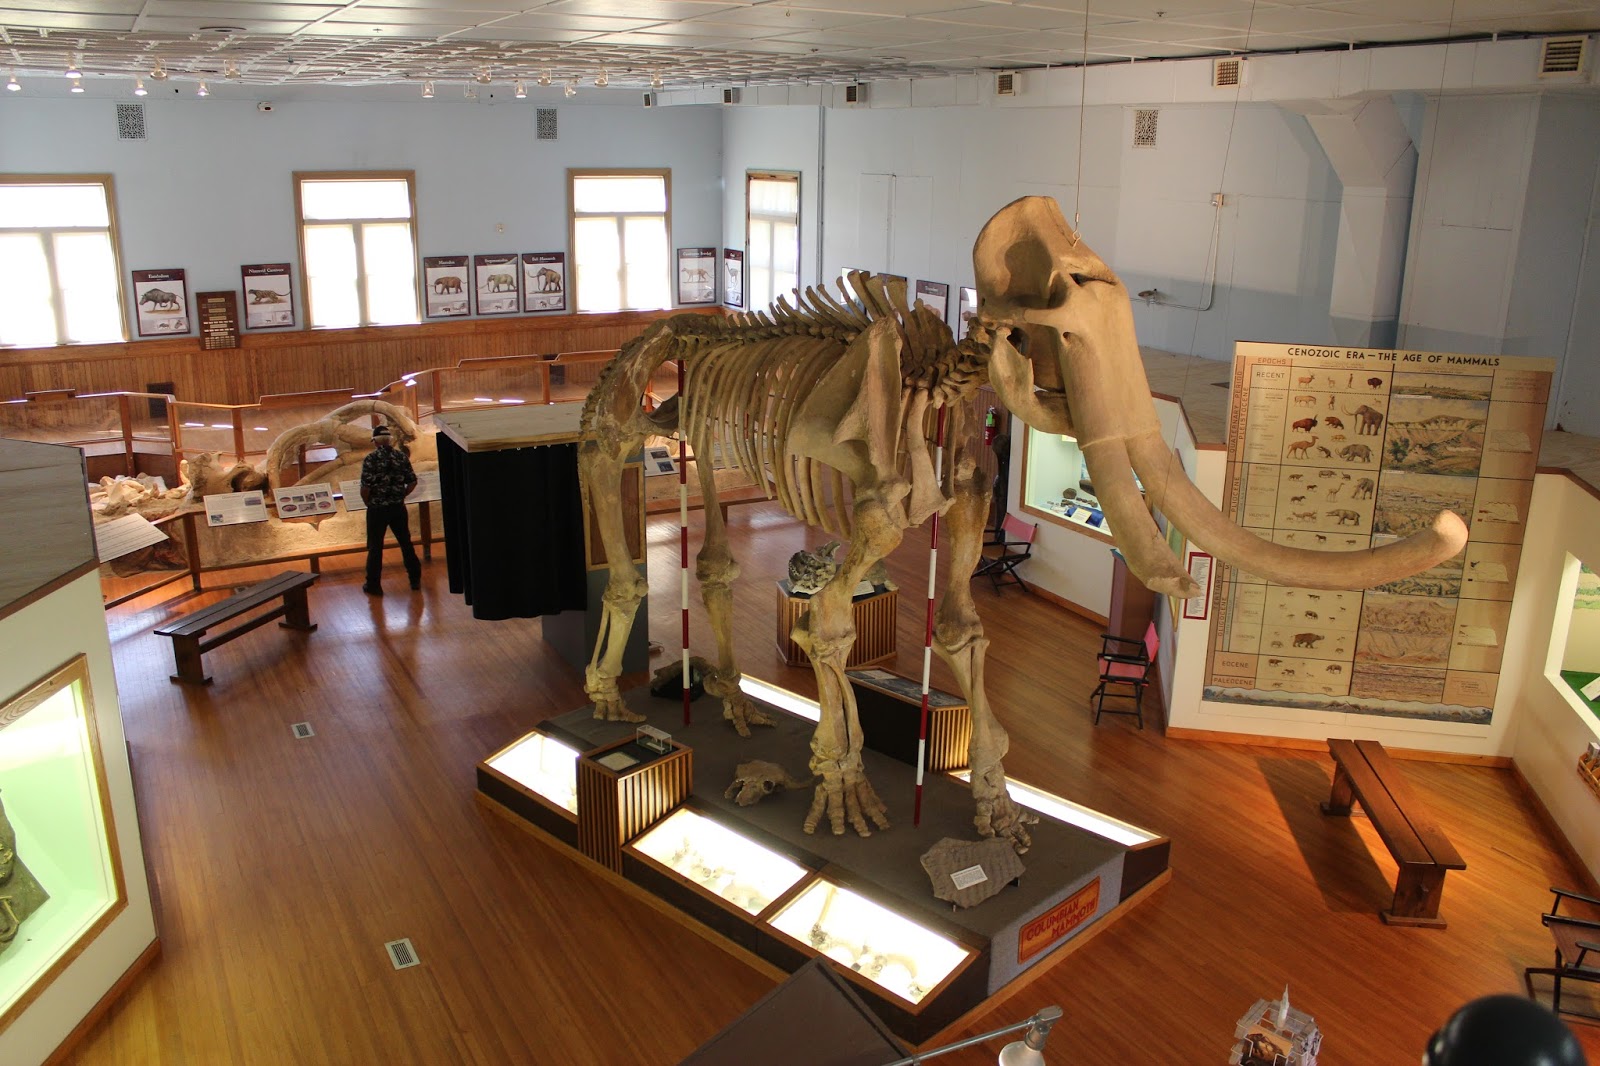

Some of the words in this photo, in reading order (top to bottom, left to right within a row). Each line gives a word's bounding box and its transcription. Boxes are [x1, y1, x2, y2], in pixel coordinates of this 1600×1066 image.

[1257, 357, 1287, 365] EPOCHS
[1287, 347, 1340, 359] CENOZOIC
[1402, 353, 1422, 363] AGE
[1428, 354, 1442, 363] OF
[1447, 355, 1500, 367] MAMMALS
[1234, 371, 1243, 399] PERIOD
[1256, 371, 1285, 379] RECENT
[1229, 405, 1240, 454] QUATERNARY
[1238, 387, 1249, 440] PLEISTOCENE
[1230, 477, 1240, 513] PLIOCENE
[1217, 597, 1227, 637] OLIGOCENE
[1221, 660, 1249, 669] EOCENE
[1213, 677, 1254, 686] PALEOCENE
[1026, 899, 1079, 941] COLUMBIAN
[1051, 897, 1096, 939] MAMMOTH
